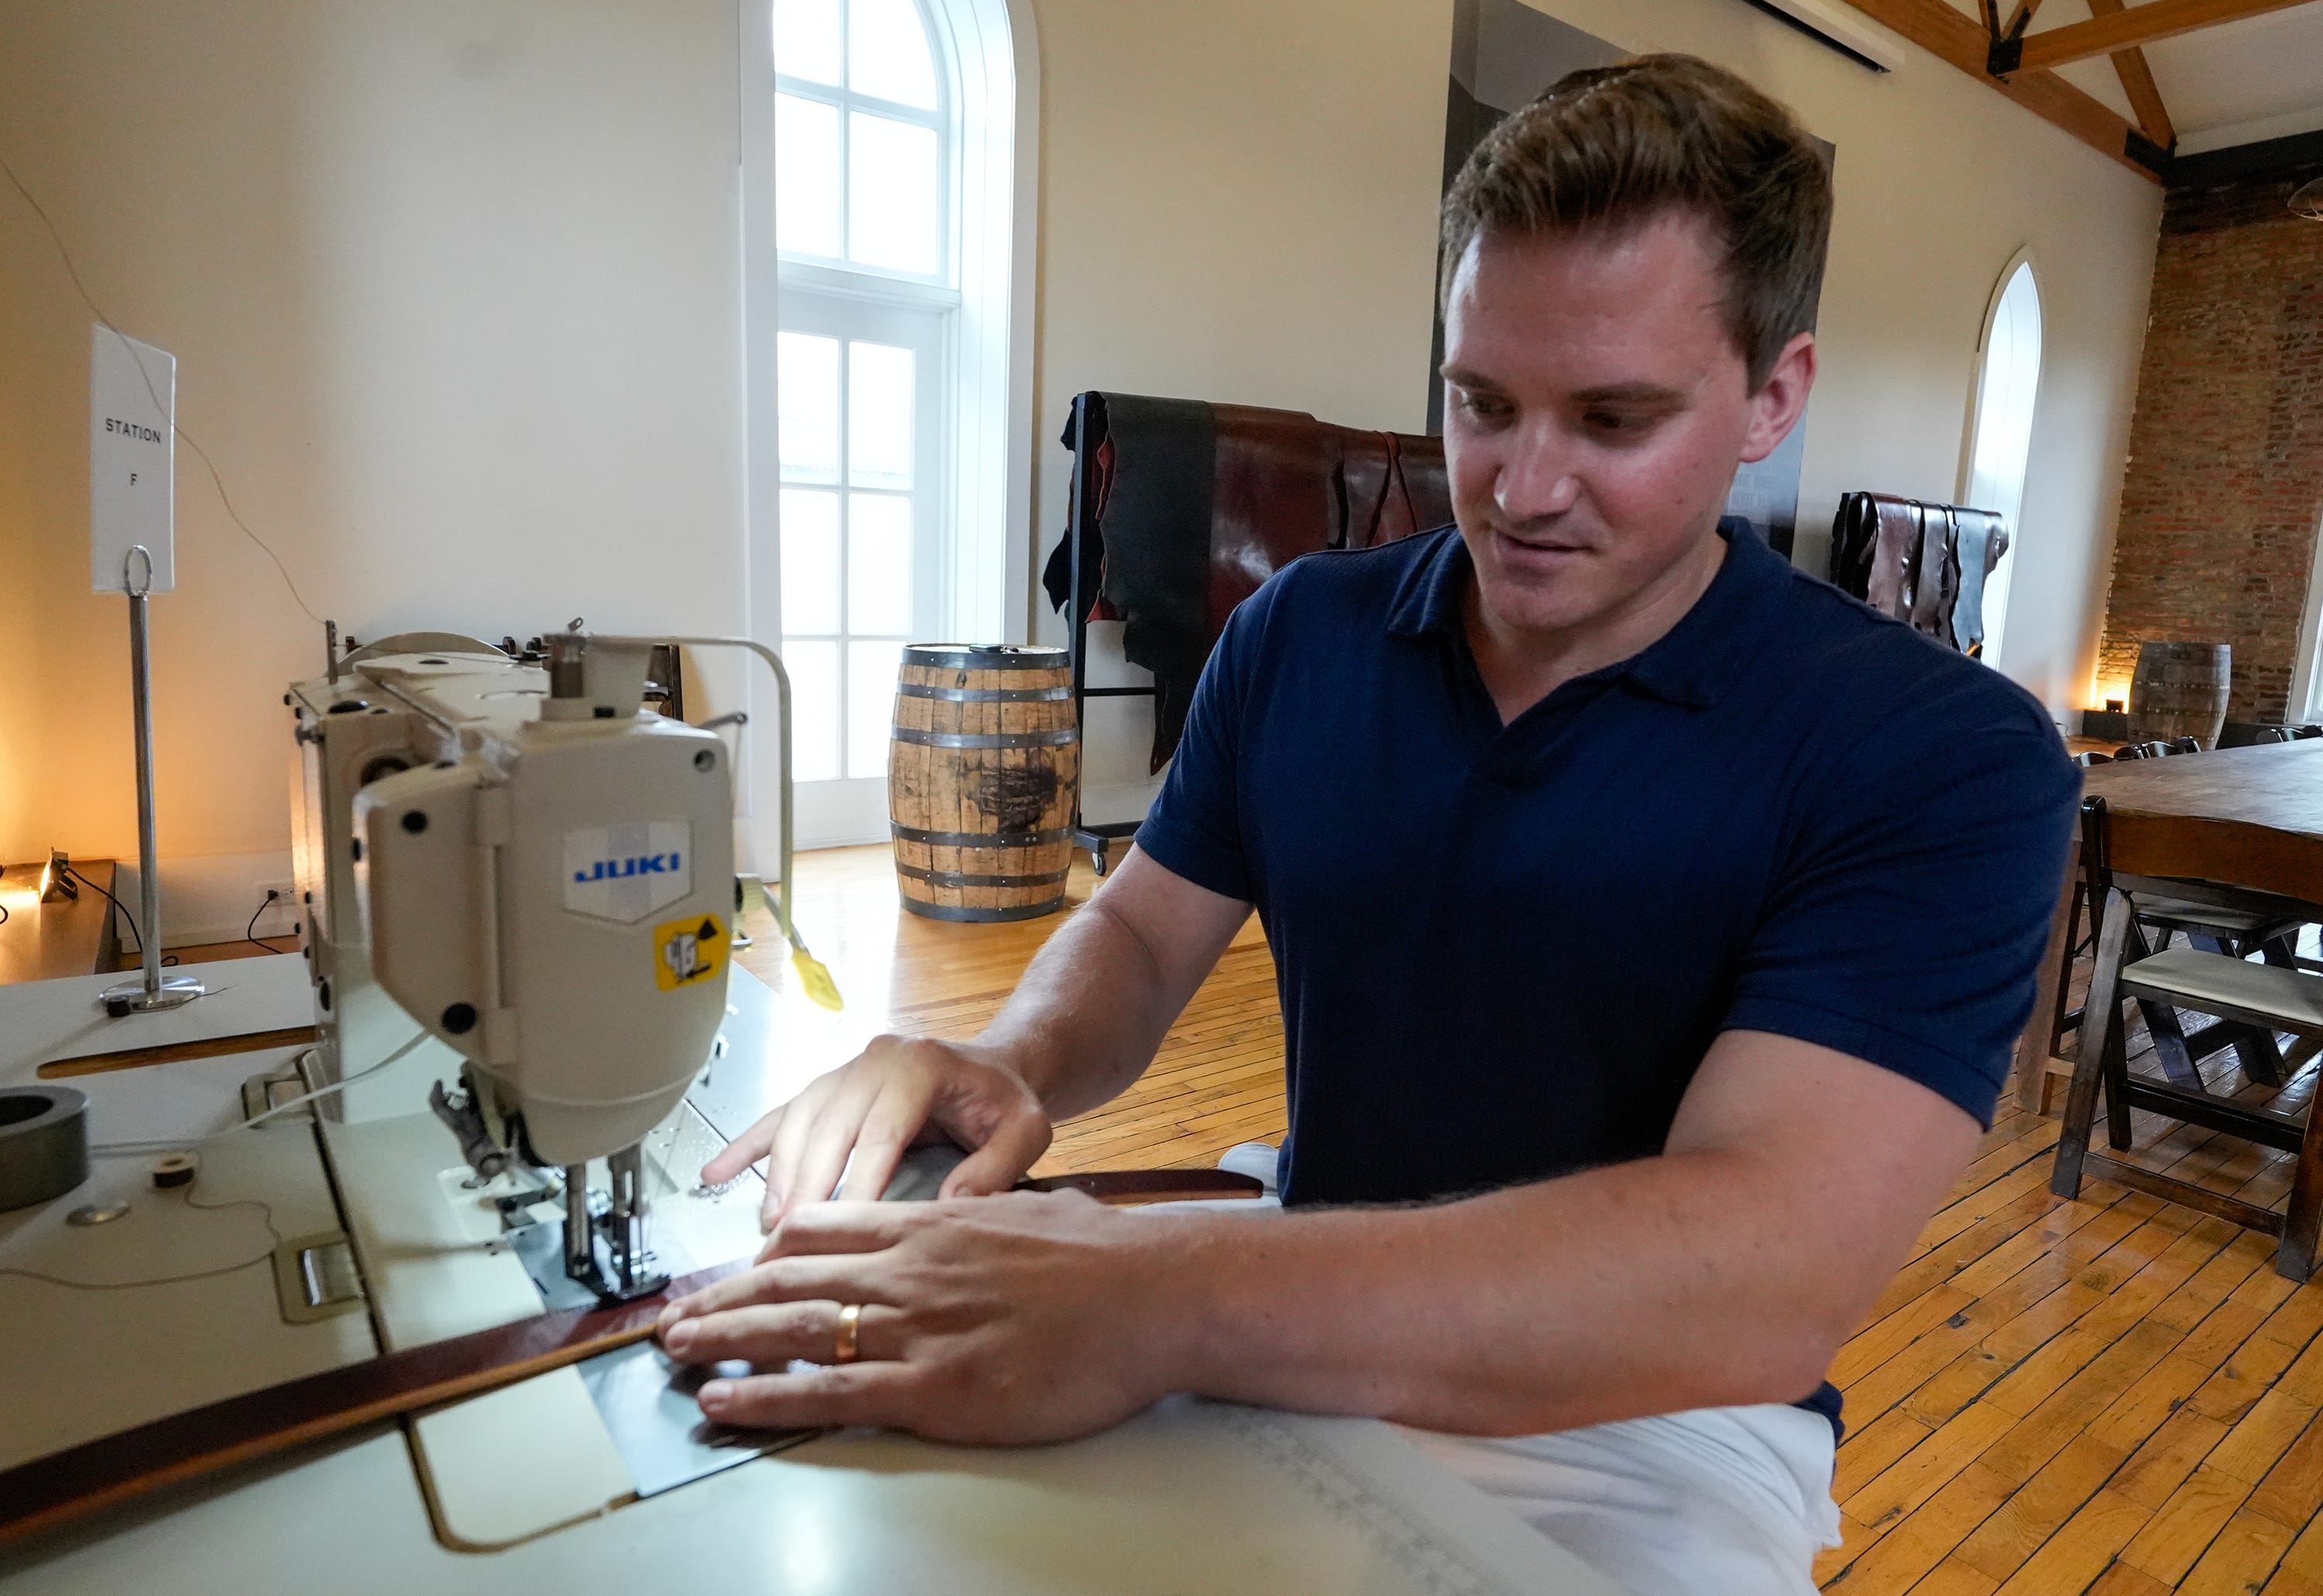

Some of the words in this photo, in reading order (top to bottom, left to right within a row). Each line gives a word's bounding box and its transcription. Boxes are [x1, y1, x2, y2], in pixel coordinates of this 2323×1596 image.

[105, 417, 161, 444] STATION
[130, 473, 138, 486] F
[575, 852, 680, 883] JUKI
